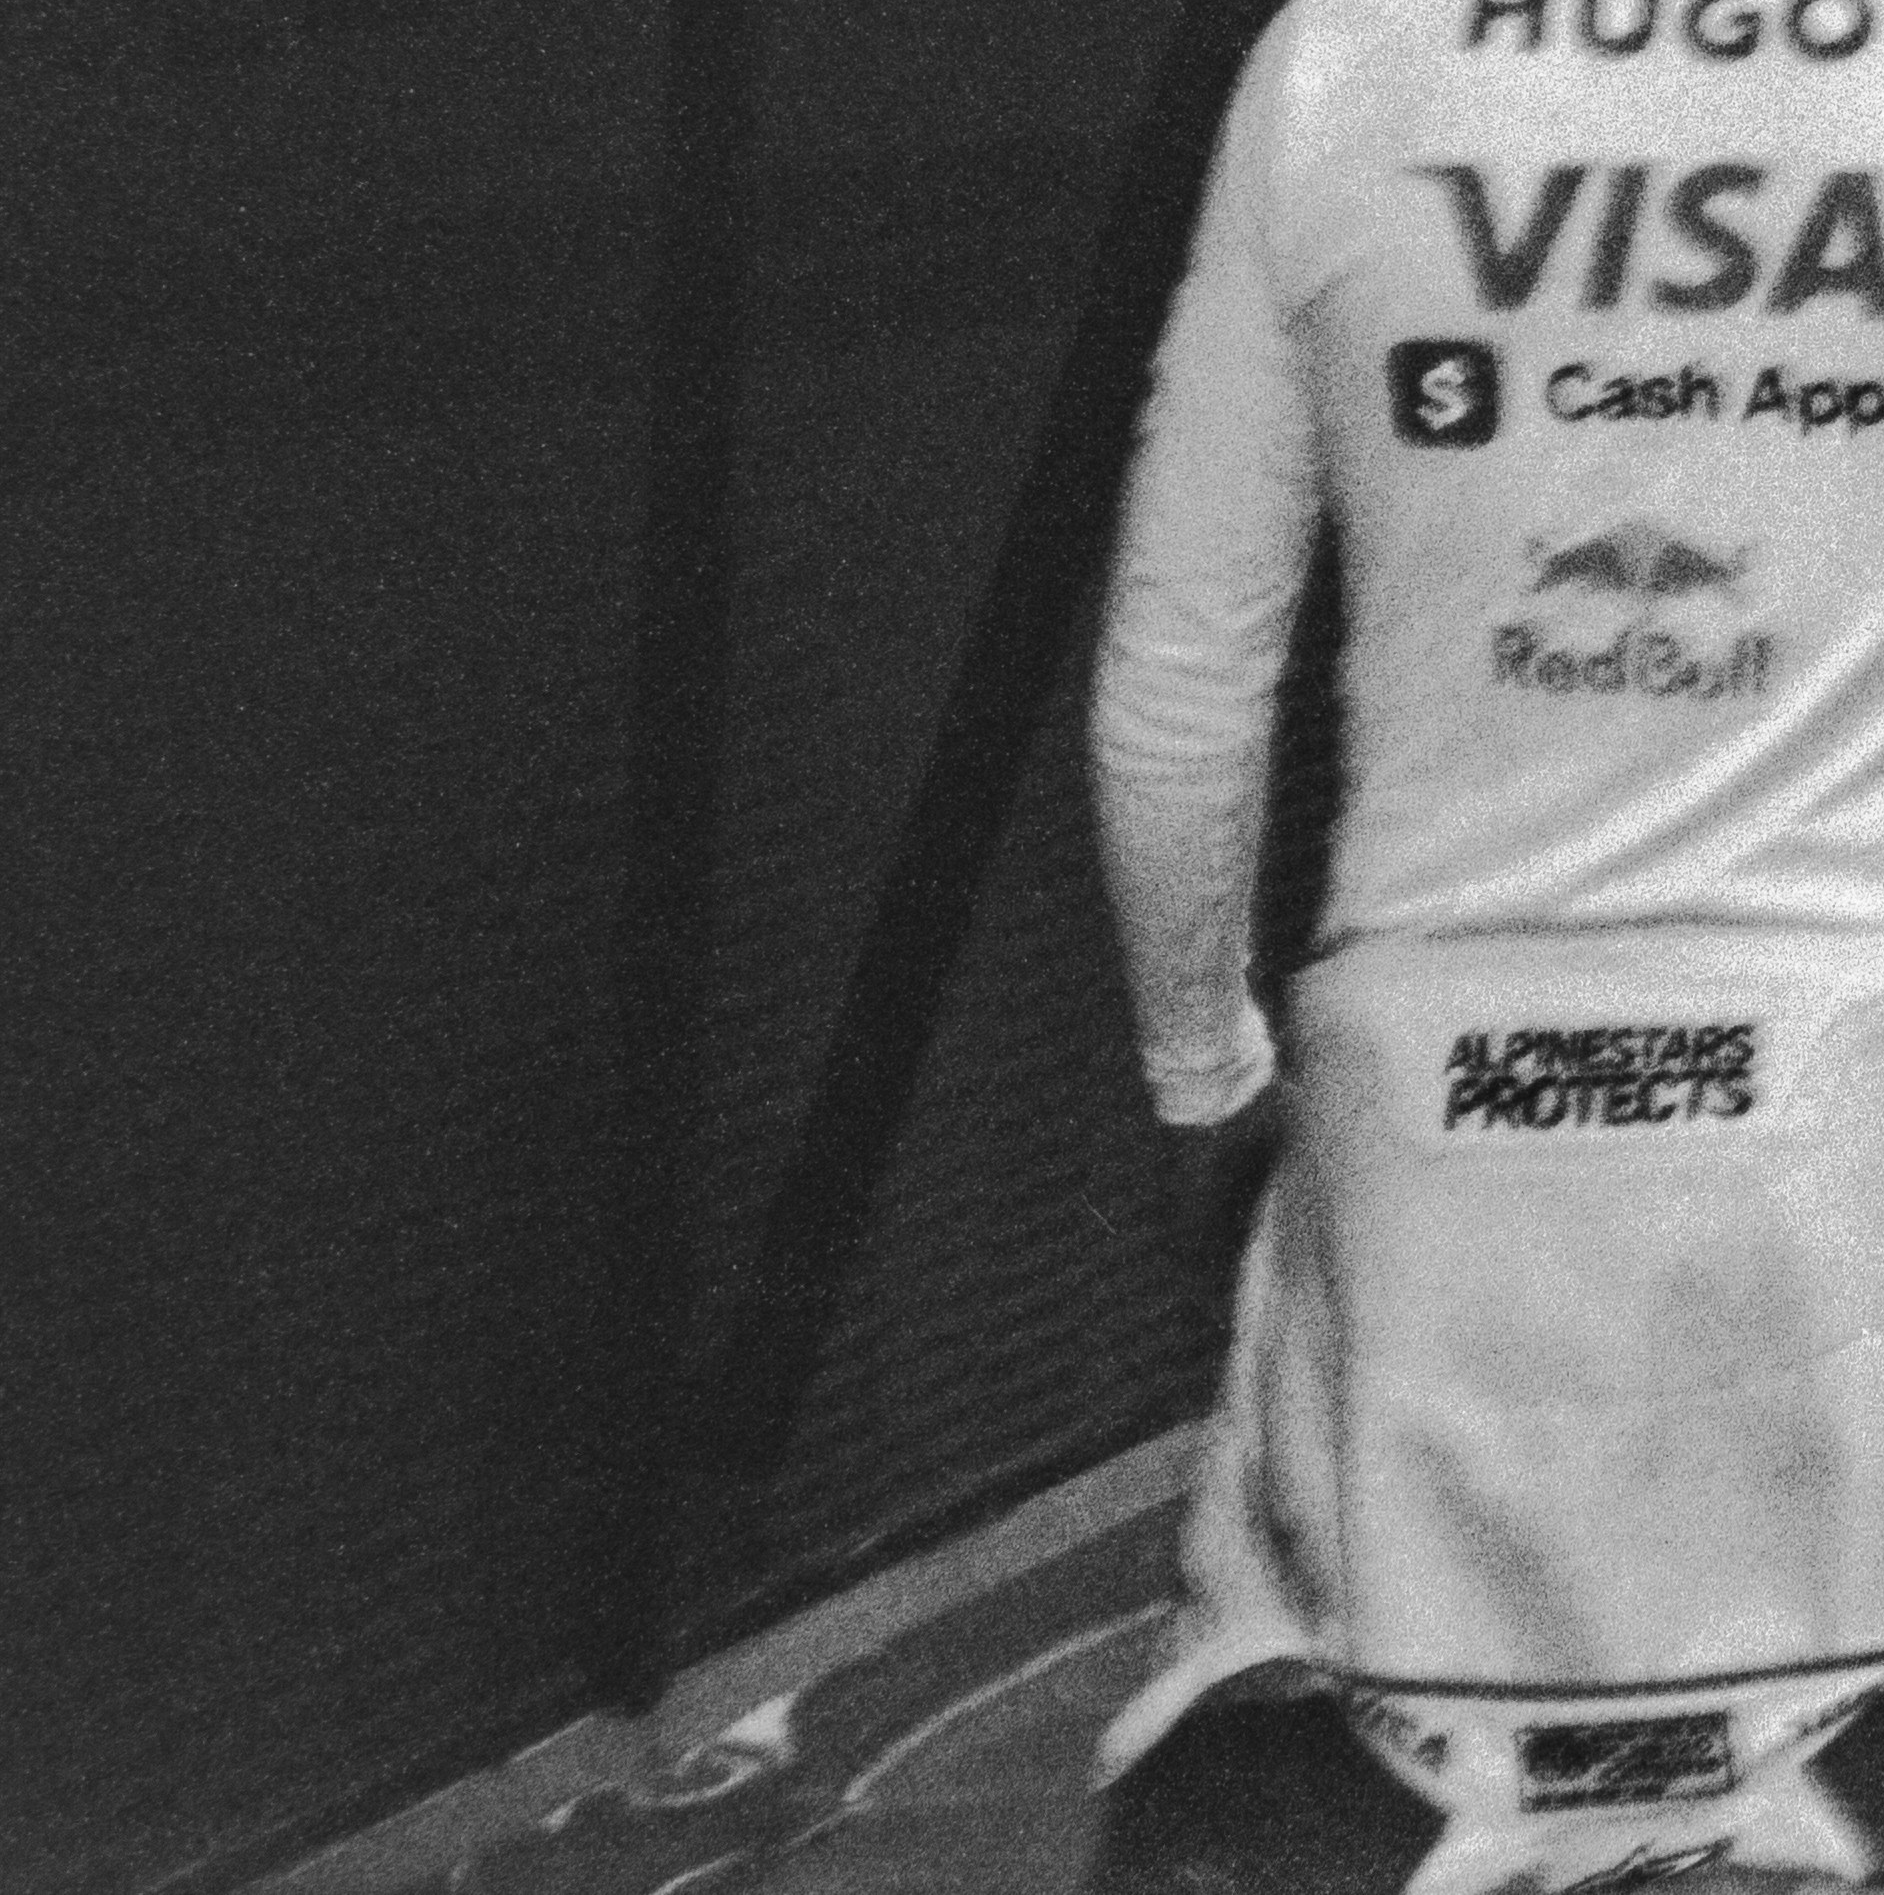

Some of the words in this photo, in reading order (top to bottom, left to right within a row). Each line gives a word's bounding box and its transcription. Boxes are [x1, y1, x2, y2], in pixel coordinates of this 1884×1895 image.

[1545, 360, 1722, 423] Cash
[1445, 1023, 1756, 1074] ALPINESTARS
[1443, 1069, 1755, 1131] PROTECTS
